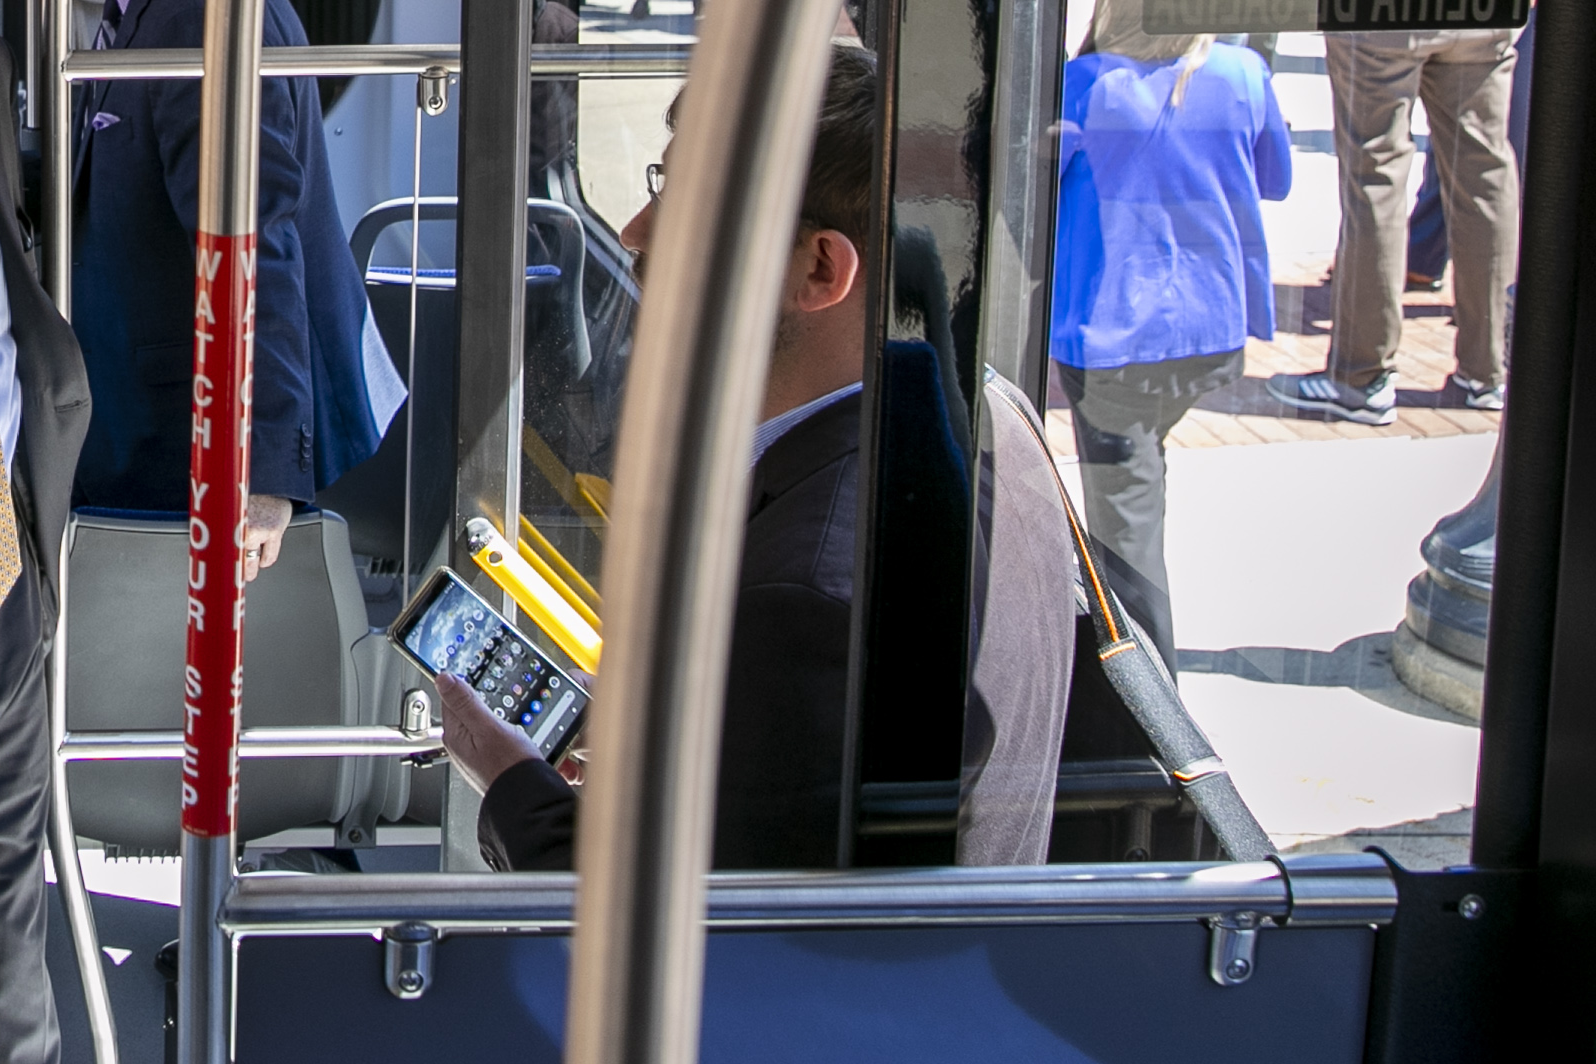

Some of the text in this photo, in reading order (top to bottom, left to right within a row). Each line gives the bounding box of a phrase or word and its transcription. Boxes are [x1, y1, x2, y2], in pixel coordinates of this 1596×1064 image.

[191, 248, 223, 450] WATCH
[187, 477, 210, 632] YOUR
[182, 664, 203, 811] STEP
